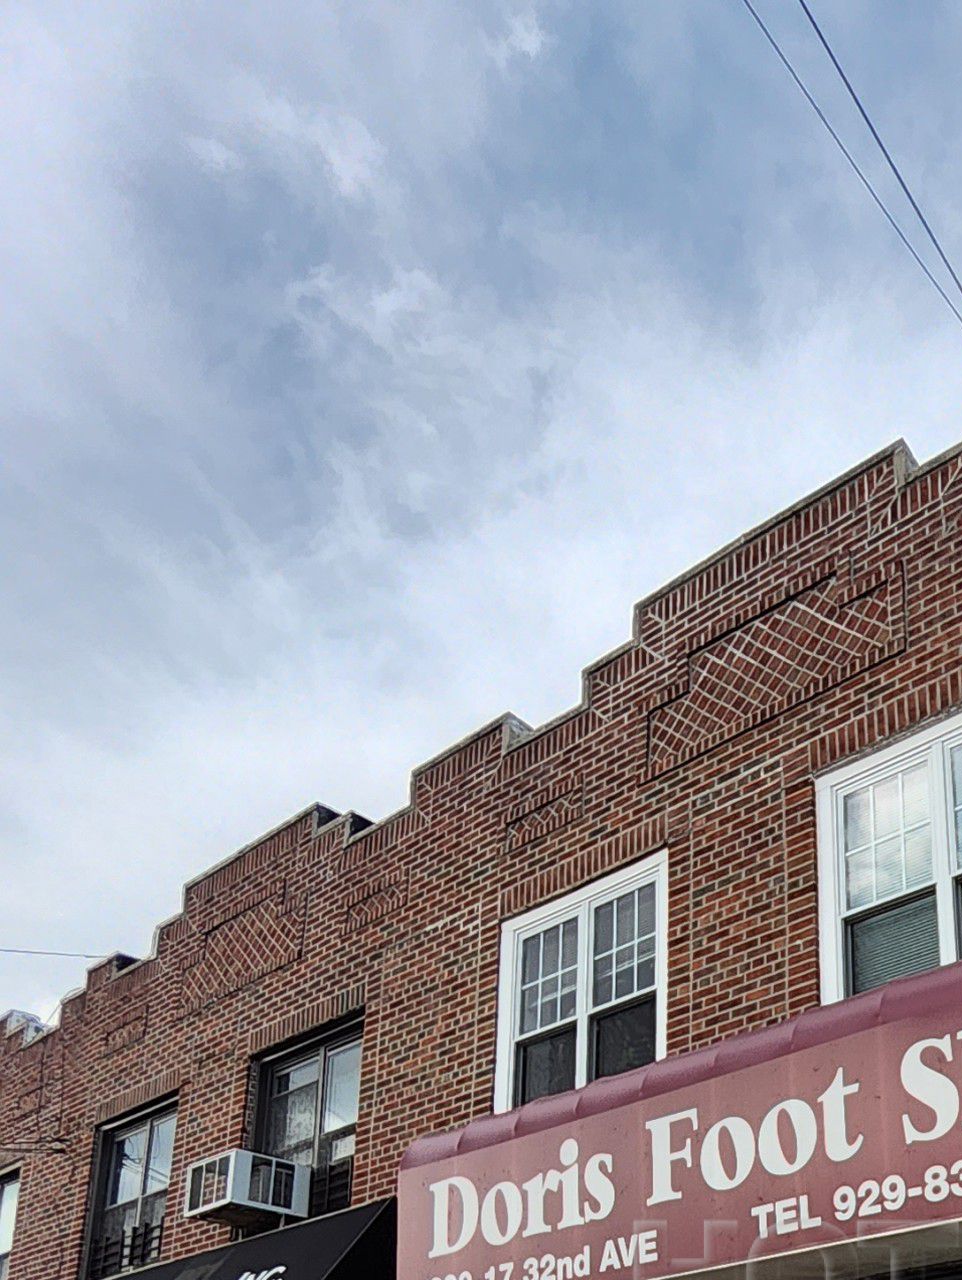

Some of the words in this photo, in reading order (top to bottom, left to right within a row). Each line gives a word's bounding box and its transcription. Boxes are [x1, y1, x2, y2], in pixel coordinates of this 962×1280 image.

[428, 1138, 615, 1258] Doris
[645, 1066, 864, 1206] Foot
[751, 1195, 822, 1239] TEL
[599, 1229, 658, 1272] AVE
